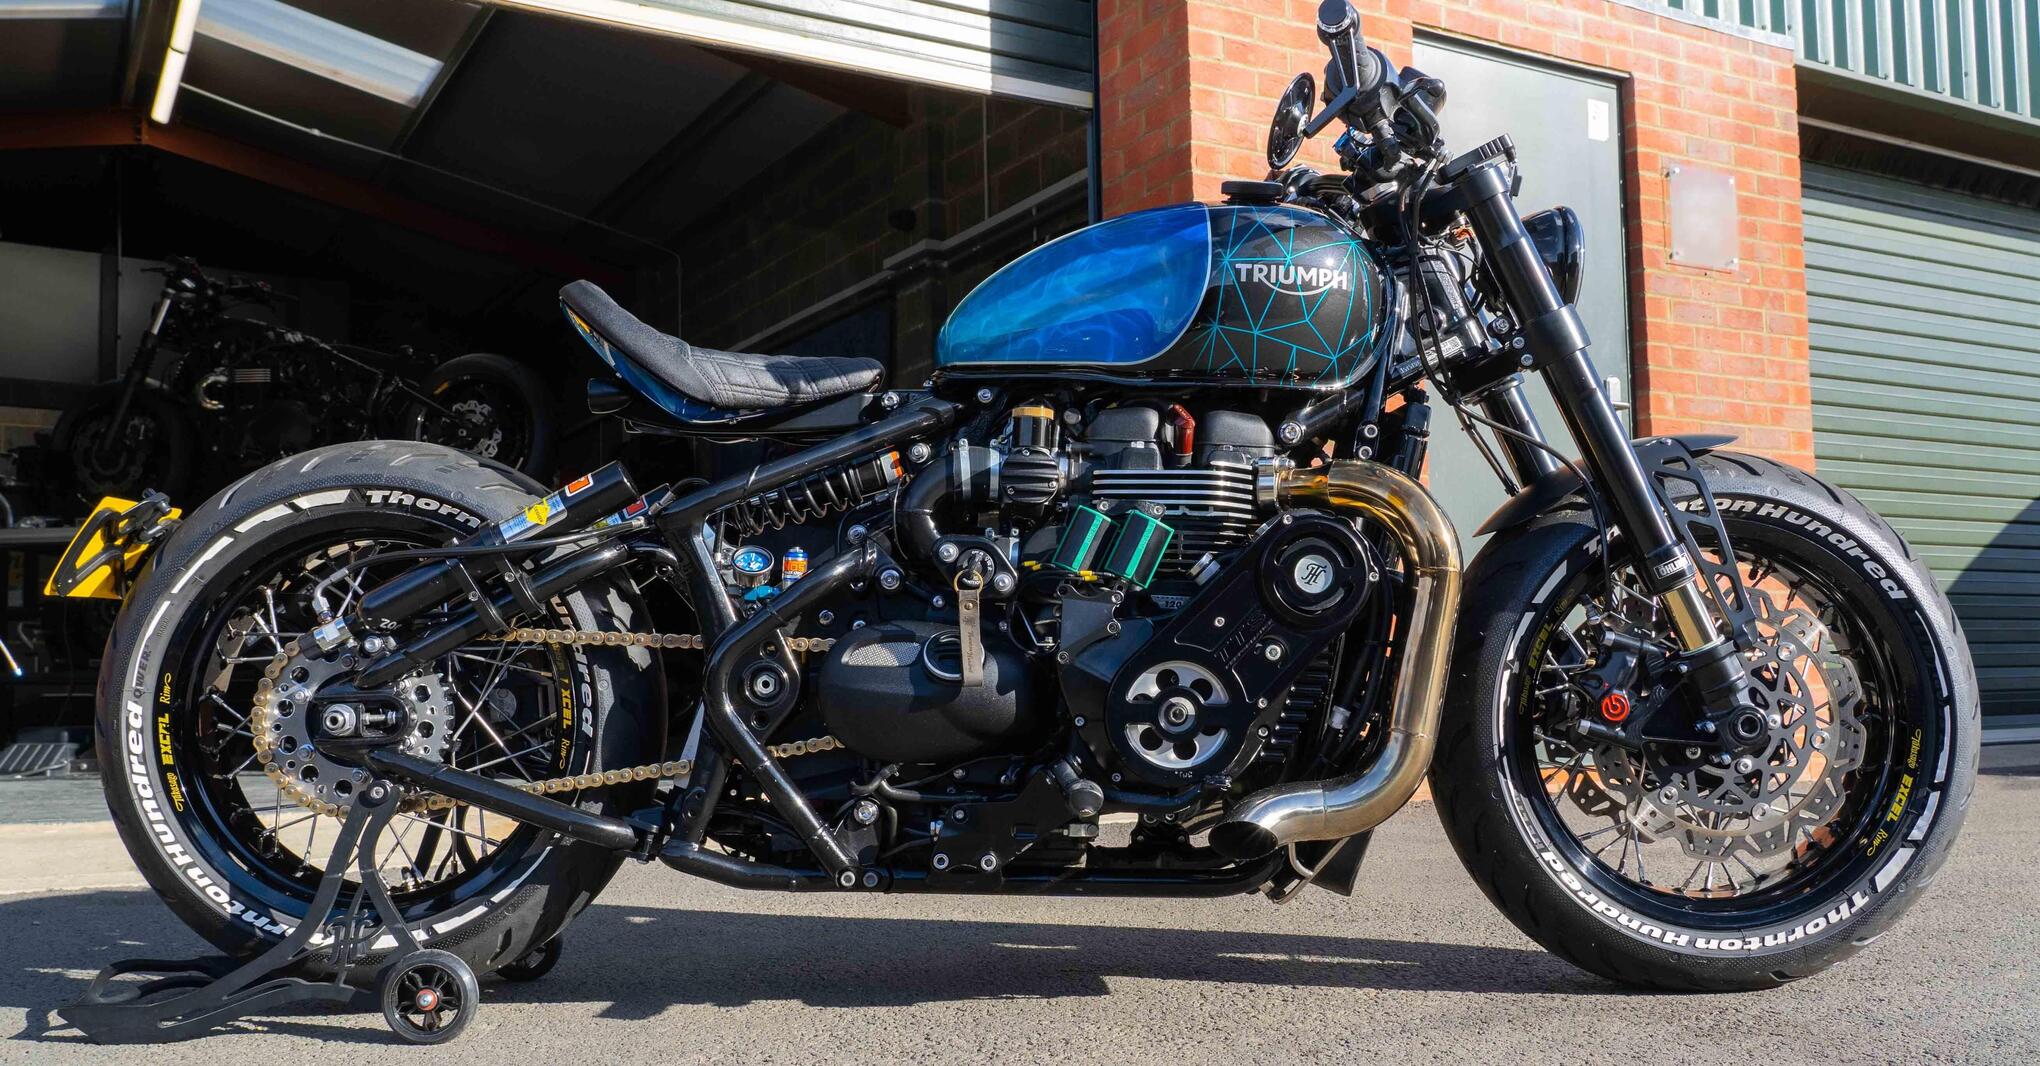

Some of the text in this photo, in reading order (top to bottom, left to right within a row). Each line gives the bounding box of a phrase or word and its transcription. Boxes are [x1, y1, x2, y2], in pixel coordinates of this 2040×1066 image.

[1235, 263, 1348, 294] TRIUMPH
[366, 490, 481, 528] Thorn
[1757, 503, 1908, 599] Hundred
[560, 678, 573, 729] XCEL
[127, 700, 194, 866] Hundred
[1887, 773, 1914, 822] EXCEL
[1541, 851, 1870, 950] Thornton Hundred
